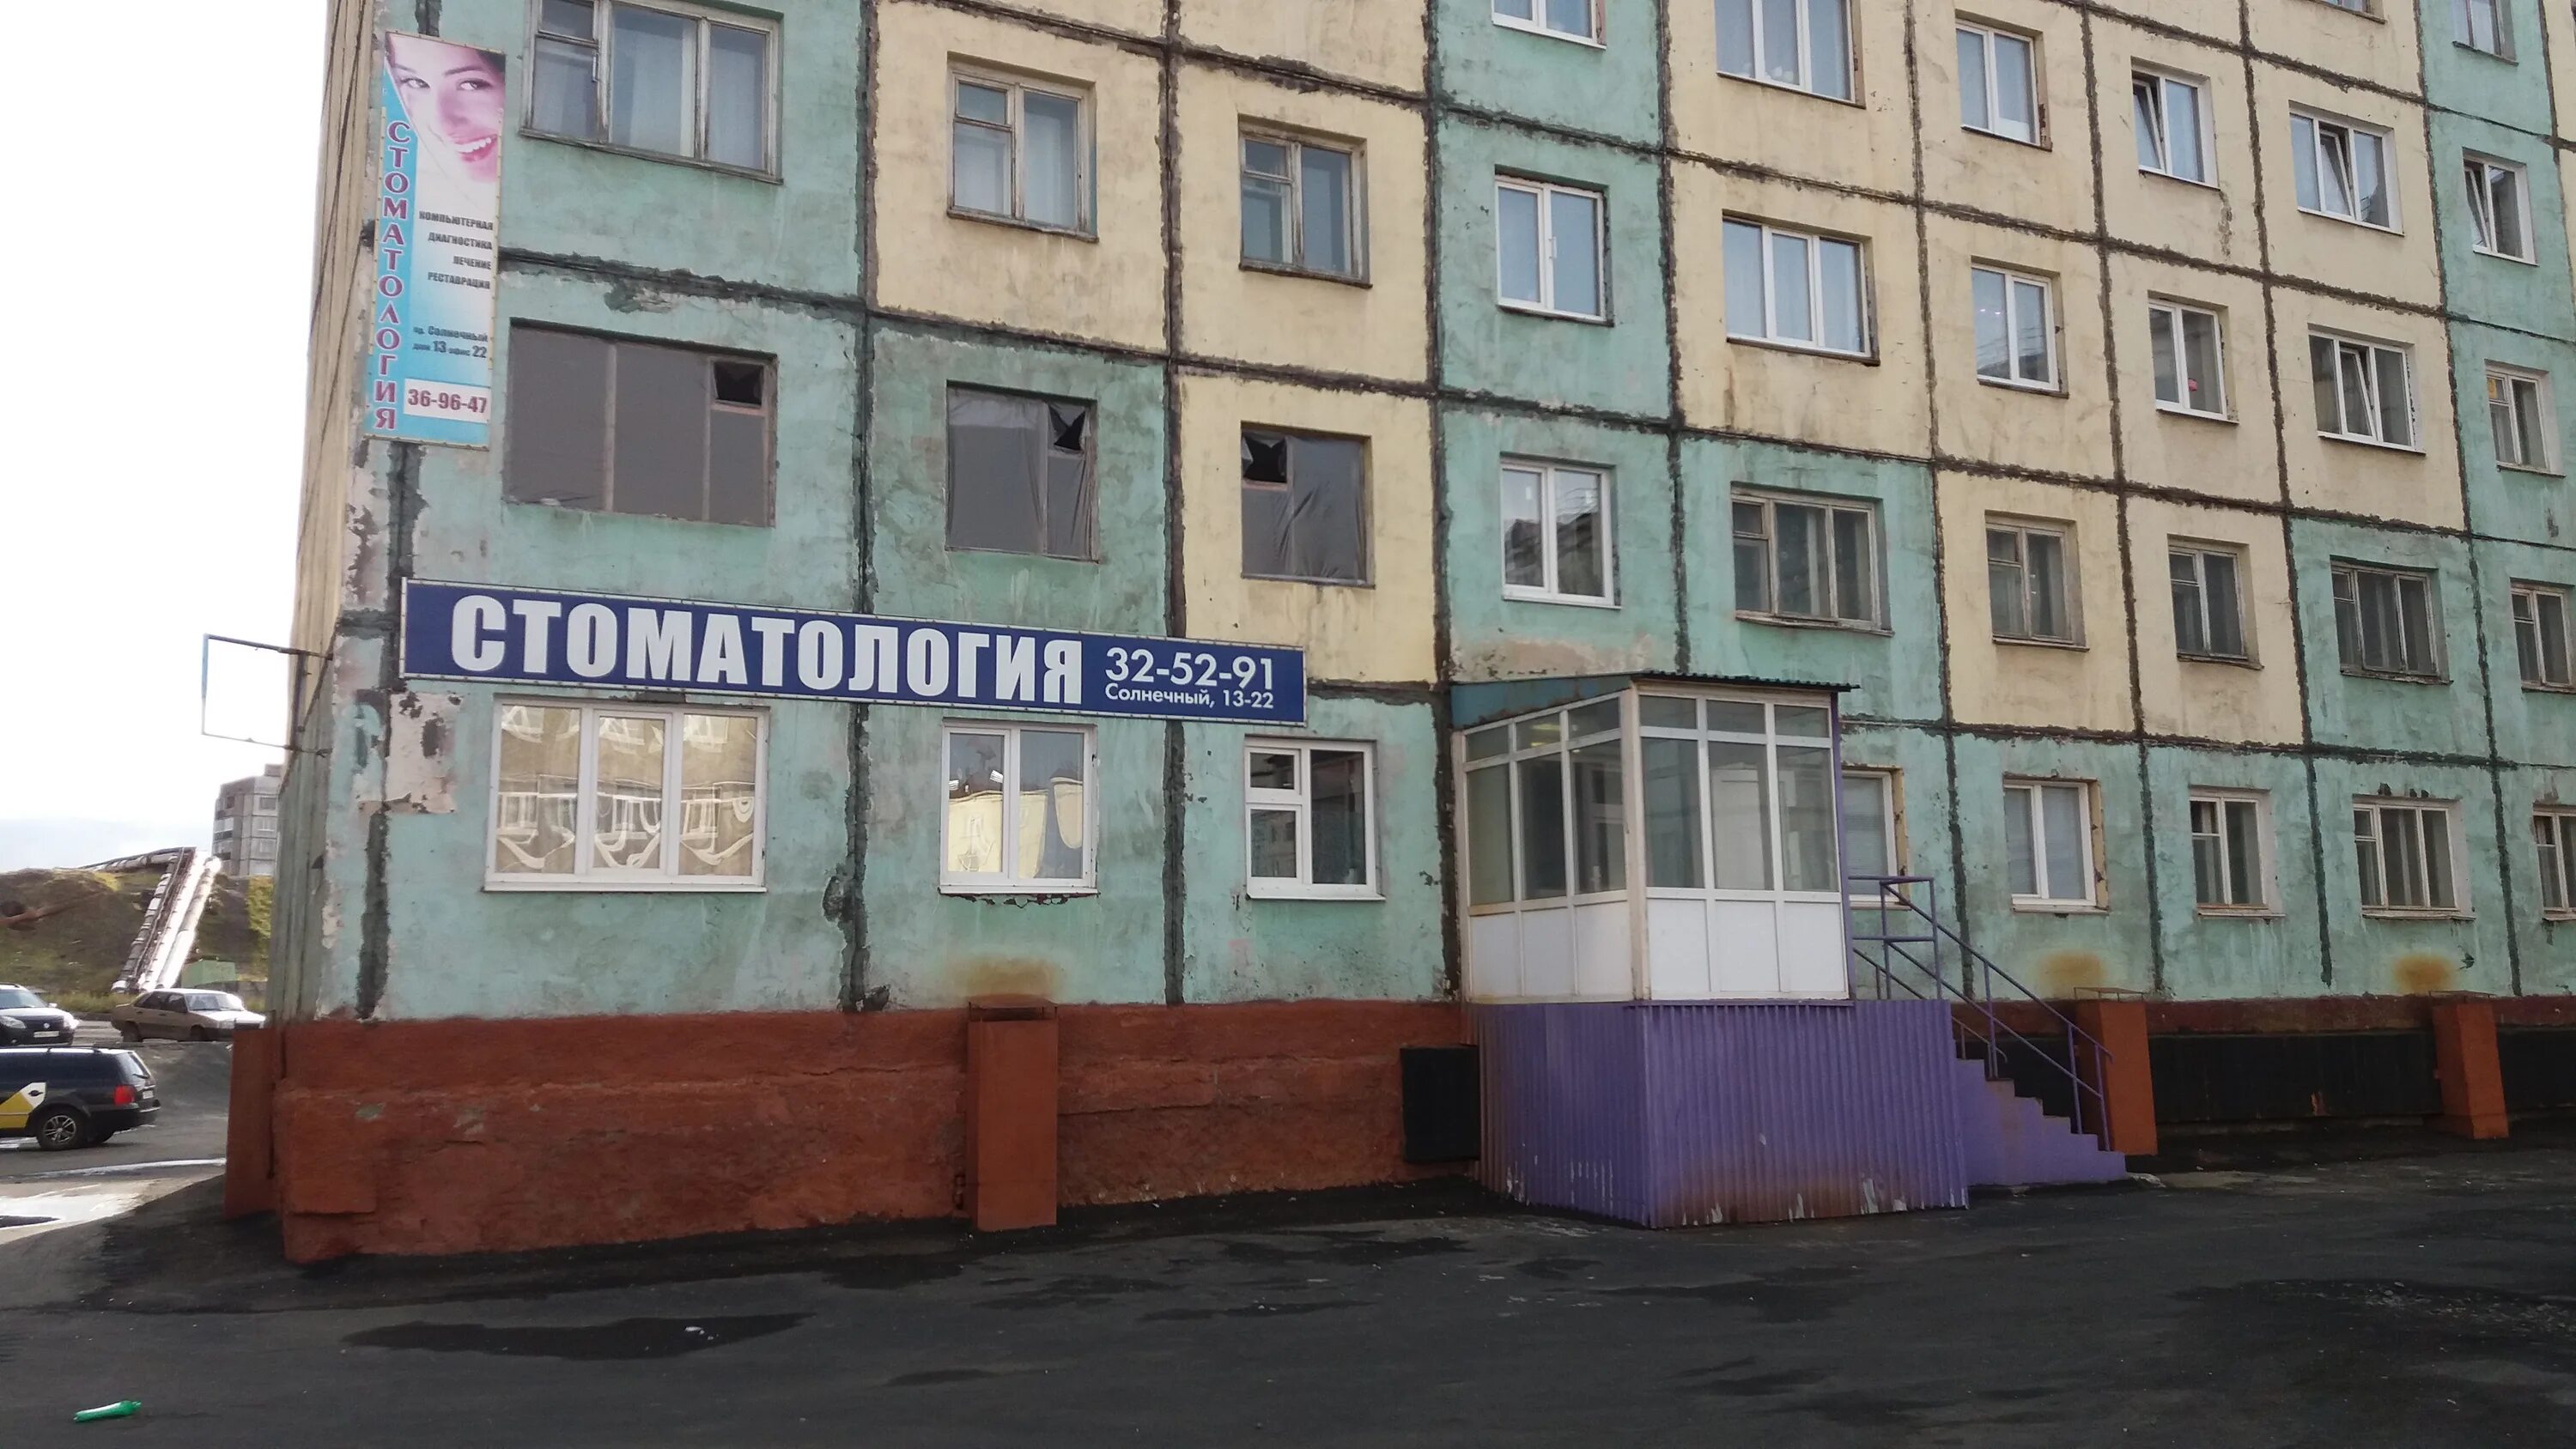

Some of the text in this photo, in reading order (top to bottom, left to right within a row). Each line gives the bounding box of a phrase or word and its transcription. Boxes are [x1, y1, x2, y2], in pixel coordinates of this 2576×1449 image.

[418, 210, 494, 231] КОМПЬЮТЕРНАЯ
[428, 232, 493, 251] ДИАГНОСТИКА
[453, 255, 491, 270] ЛЕЧЕНИЕ
[374, 120, 412, 431] СТОМАТОЛОГИЯ
[427, 271, 490, 290] РЕСТАВРАЦИЯ
[433, 340, 447, 354] 13
[471, 344, 488, 359] 22
[407, 388, 488, 414] 36-96-47
[451, 594, 1083, 705] СТОМАТОЛОГИЯ
[1104, 646, 1273, 690] 32-52-91
[1104, 682, 1274, 709] Солнечный, 13-22
